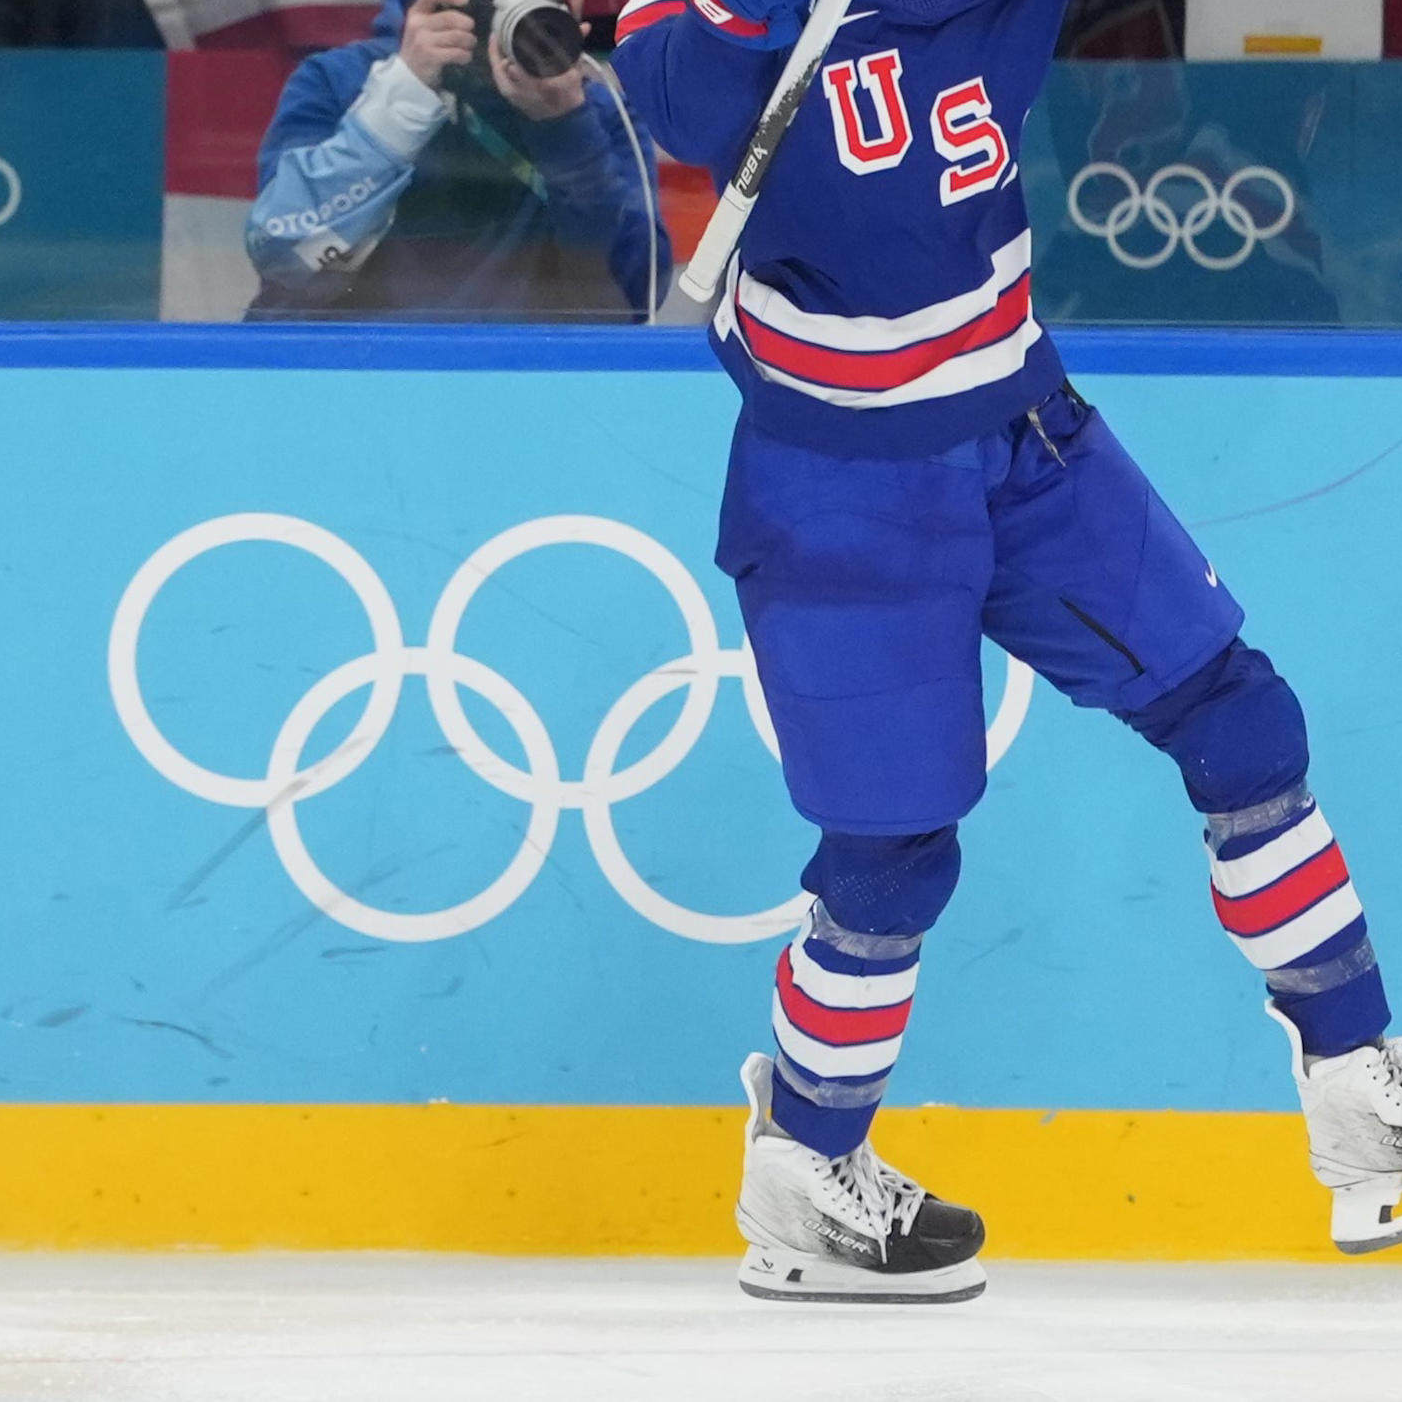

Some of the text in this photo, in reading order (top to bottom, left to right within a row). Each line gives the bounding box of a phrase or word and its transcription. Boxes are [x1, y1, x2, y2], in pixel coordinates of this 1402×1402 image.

[822, 48, 1019, 207] US
[735, 154, 758, 194] BAU
[263, 176, 376, 238] OTOPOOL
